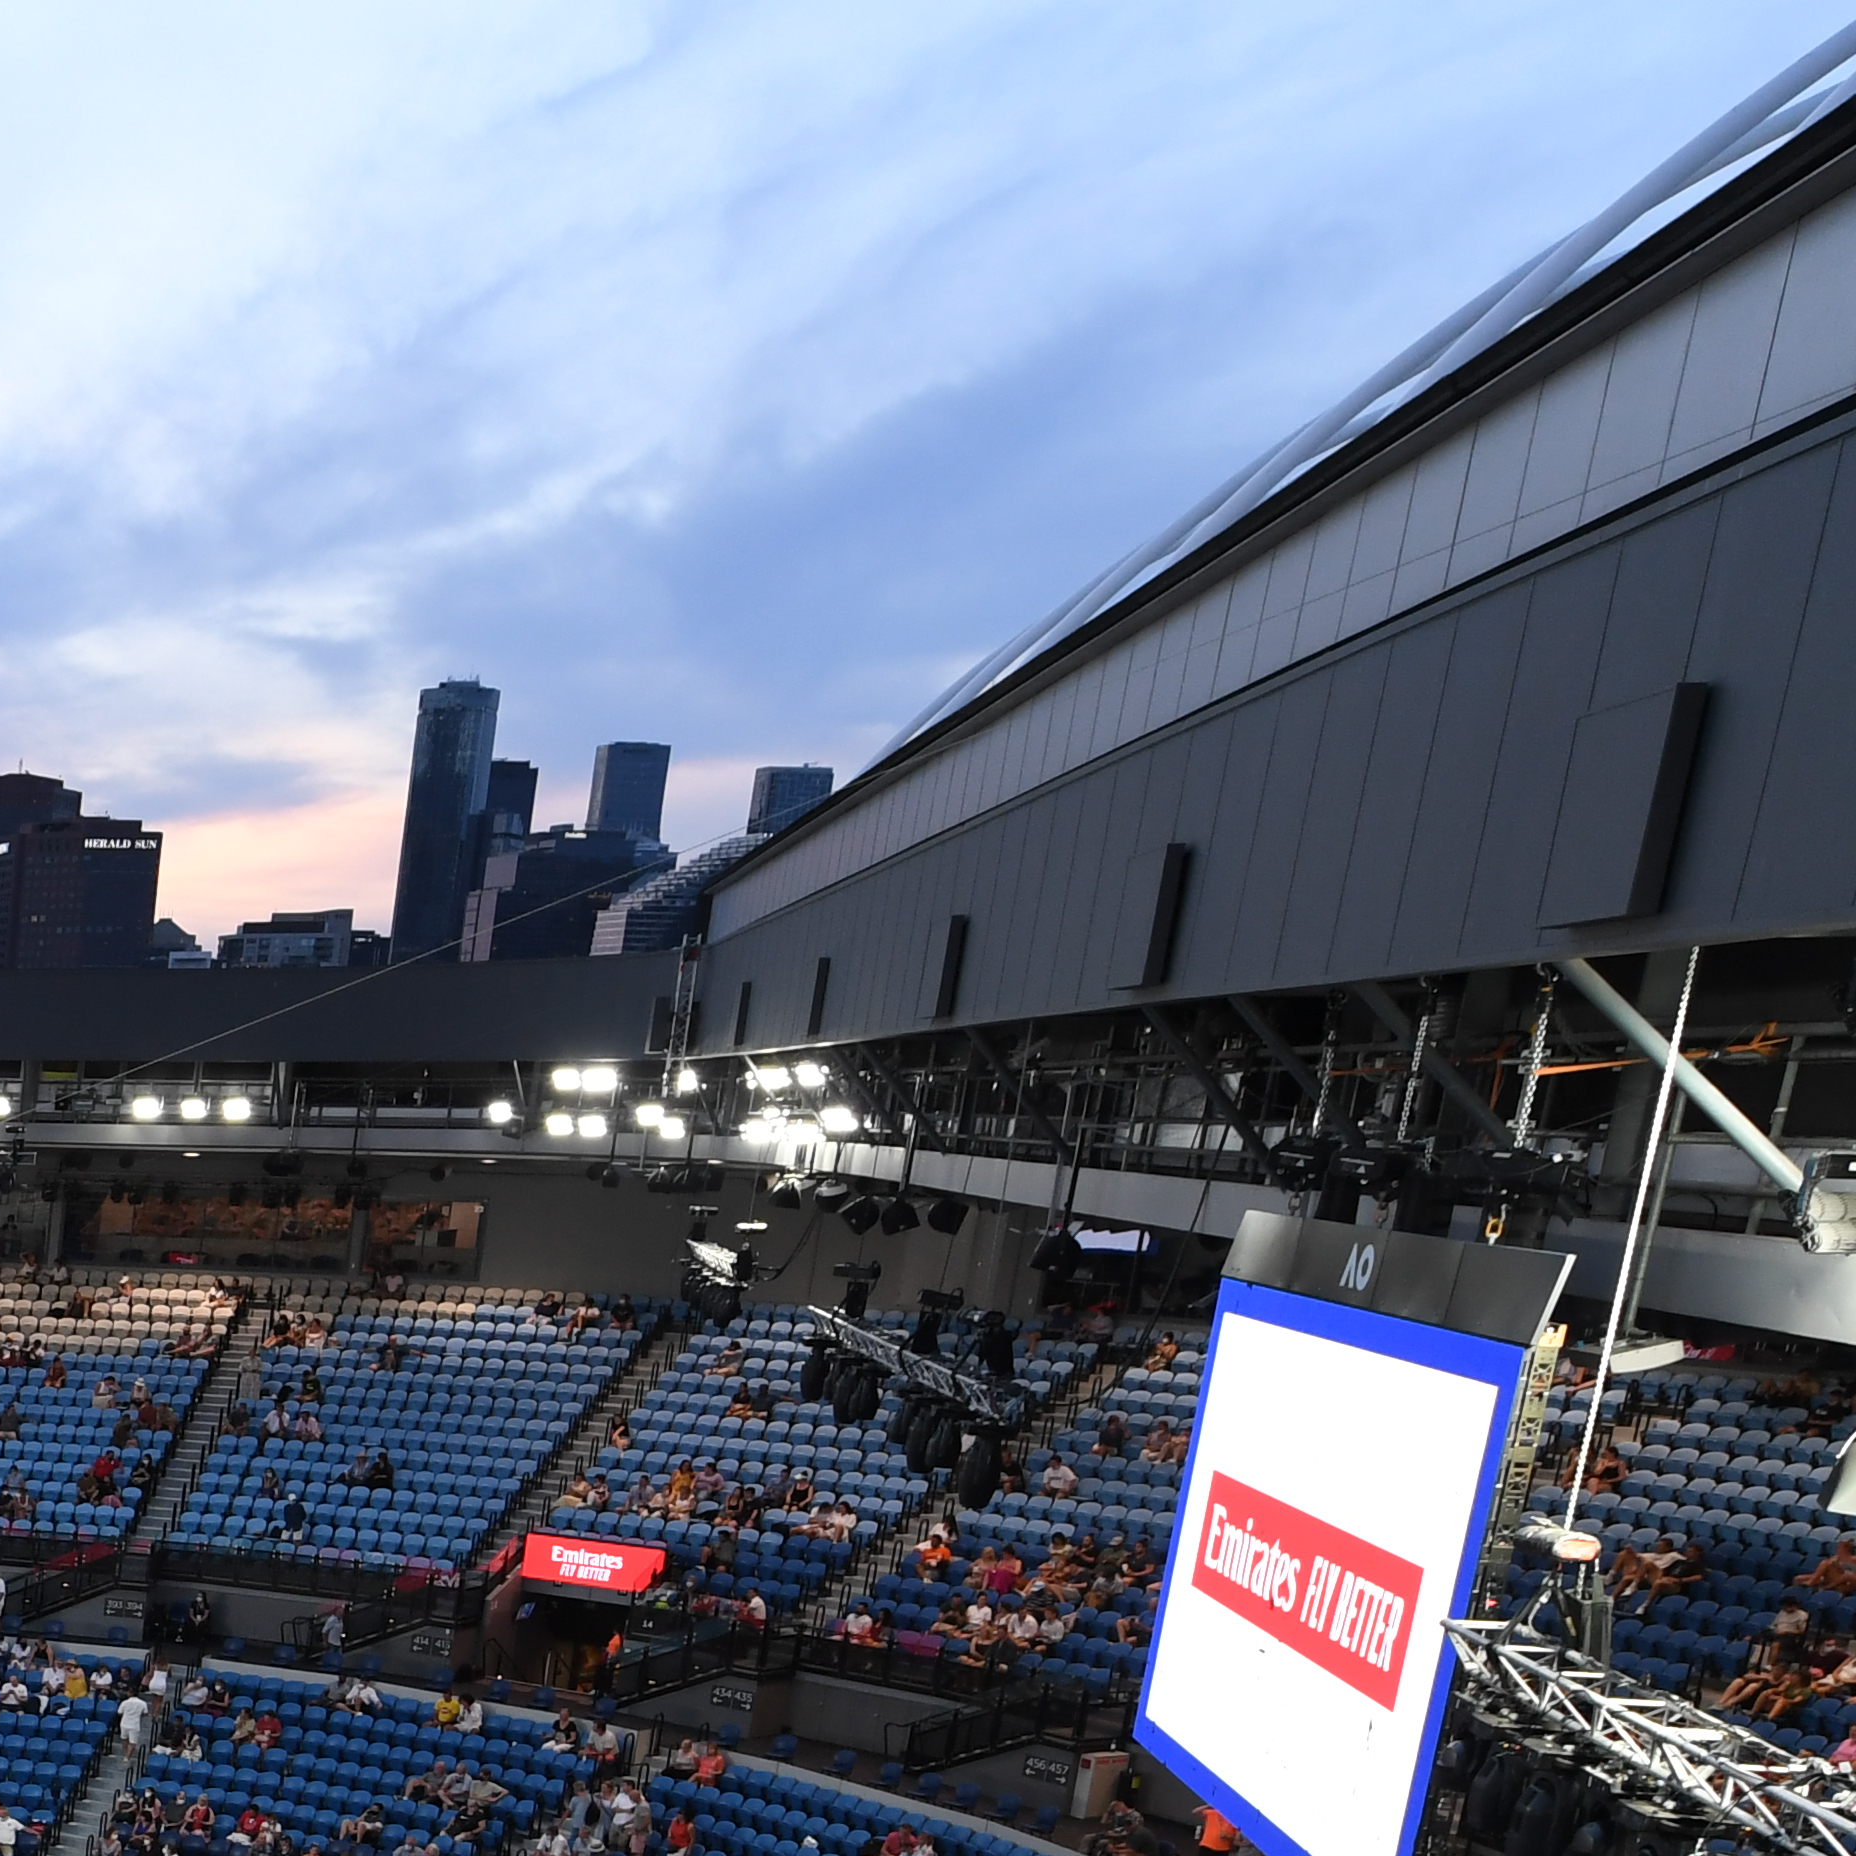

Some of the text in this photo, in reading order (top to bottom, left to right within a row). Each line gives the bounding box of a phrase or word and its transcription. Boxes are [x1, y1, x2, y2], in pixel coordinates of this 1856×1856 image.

[85, 839, 158, 850] HERALD SUN
[1338, 1242, 1375, 1292] AO
[551, 1546, 623, 1570] Emirates
[559, 1564, 612, 1582] FLY BETTER
[1204, 1502, 1405, 1673] Emirates FLY BETTER
[106, 1600, 143, 1611] 393 394
[642, 1620, 654, 1628] 14
[413, 1637, 451, 1650] 414 415
[713, 1687, 753, 1702] 434 435
[1026, 1758, 1070, 1775] 456 457
